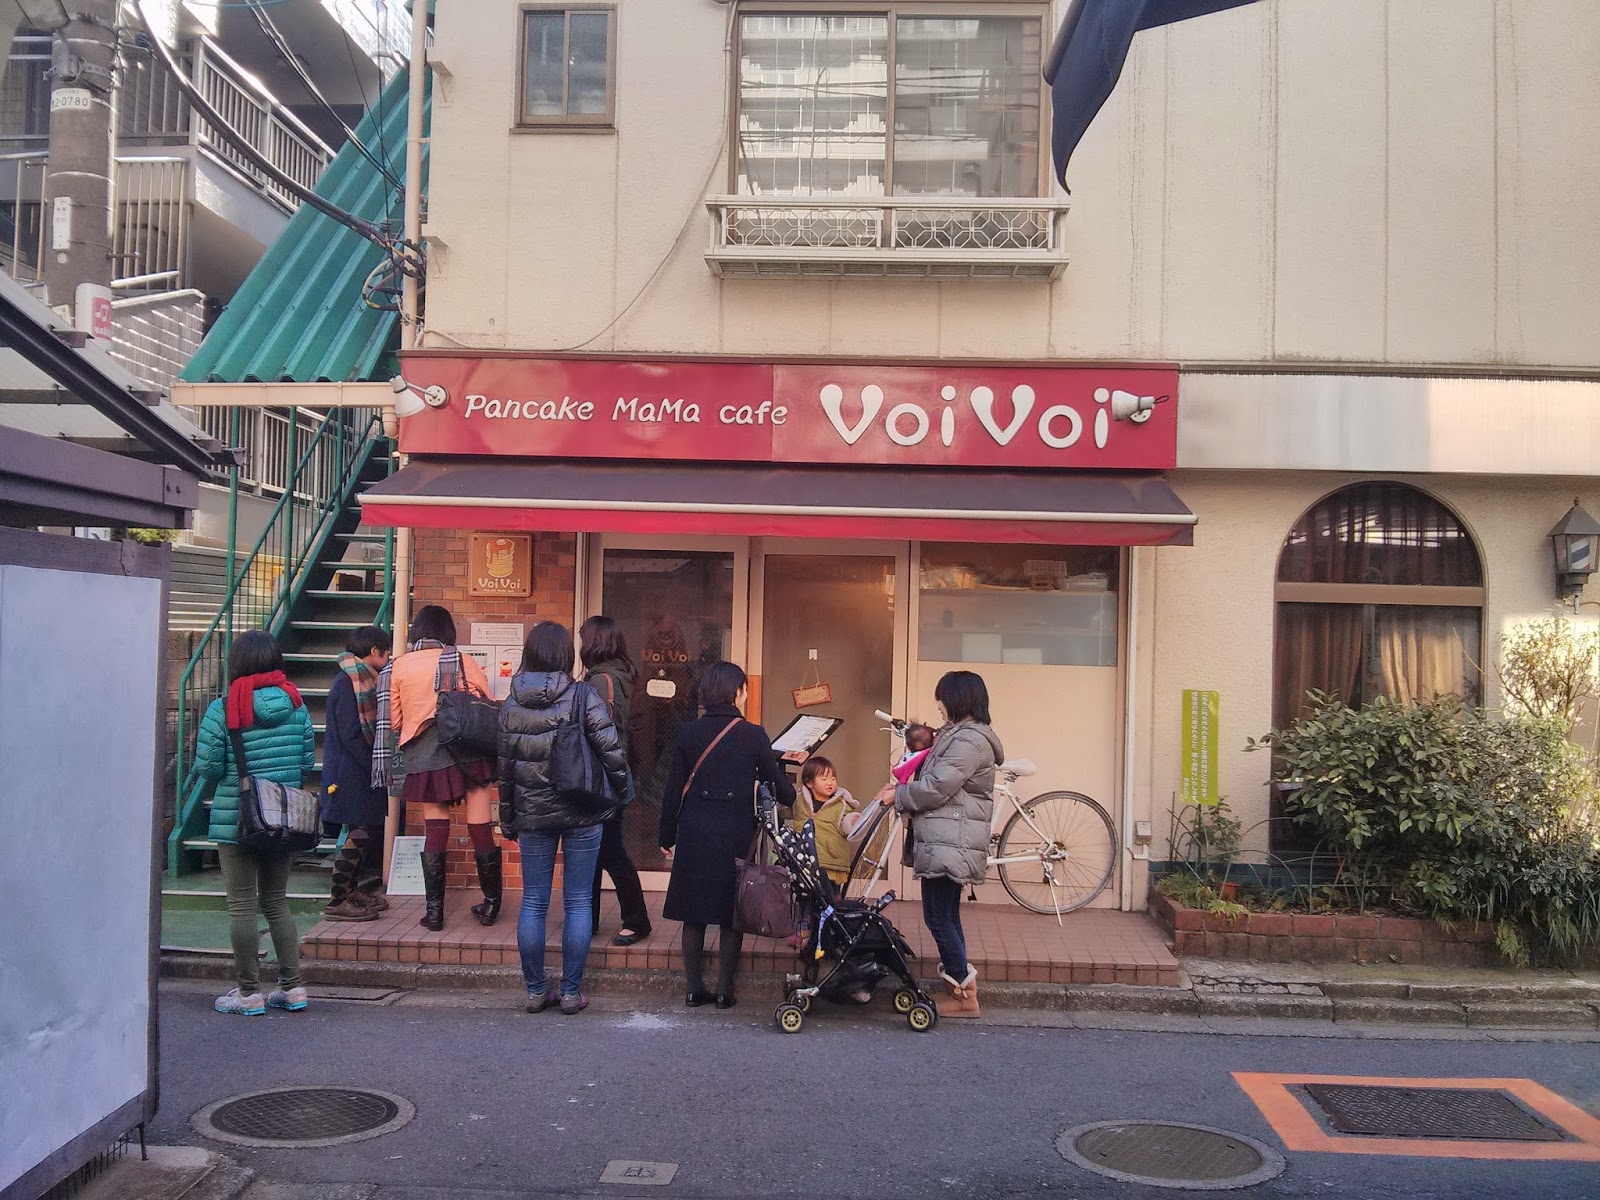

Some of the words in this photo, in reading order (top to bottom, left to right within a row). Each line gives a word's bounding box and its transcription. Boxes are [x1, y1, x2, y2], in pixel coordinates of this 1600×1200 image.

[464, 394, 595, 421] Pancake
[611, 396, 700, 423] MaMa
[718, 400, 788, 425] cafe
